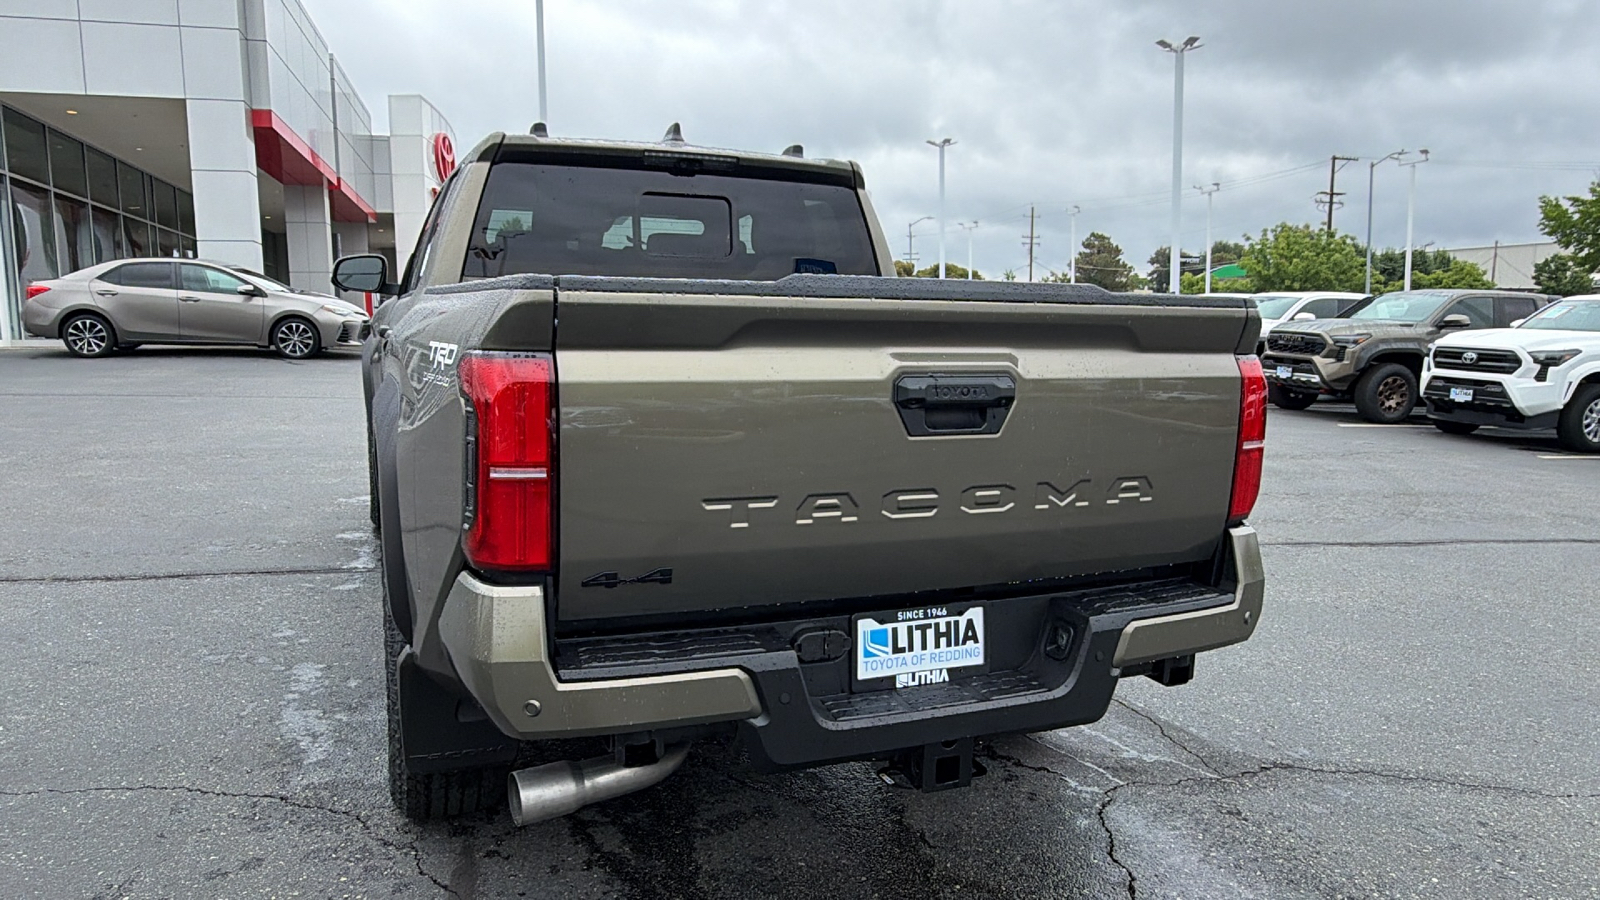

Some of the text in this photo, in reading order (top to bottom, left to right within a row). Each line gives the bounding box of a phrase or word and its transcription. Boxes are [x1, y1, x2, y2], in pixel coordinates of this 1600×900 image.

[429, 341, 458, 370] TRD
[932, 386, 990, 399] TOYOTA
[701, 475, 1153, 528] TACOMA
[897, 607, 947, 621] SINCE 1946
[891, 618, 980, 655] LITHIA
[863, 647, 981, 672] TOYOTA OF REDDING
[907, 668, 950, 686] LITHIA
